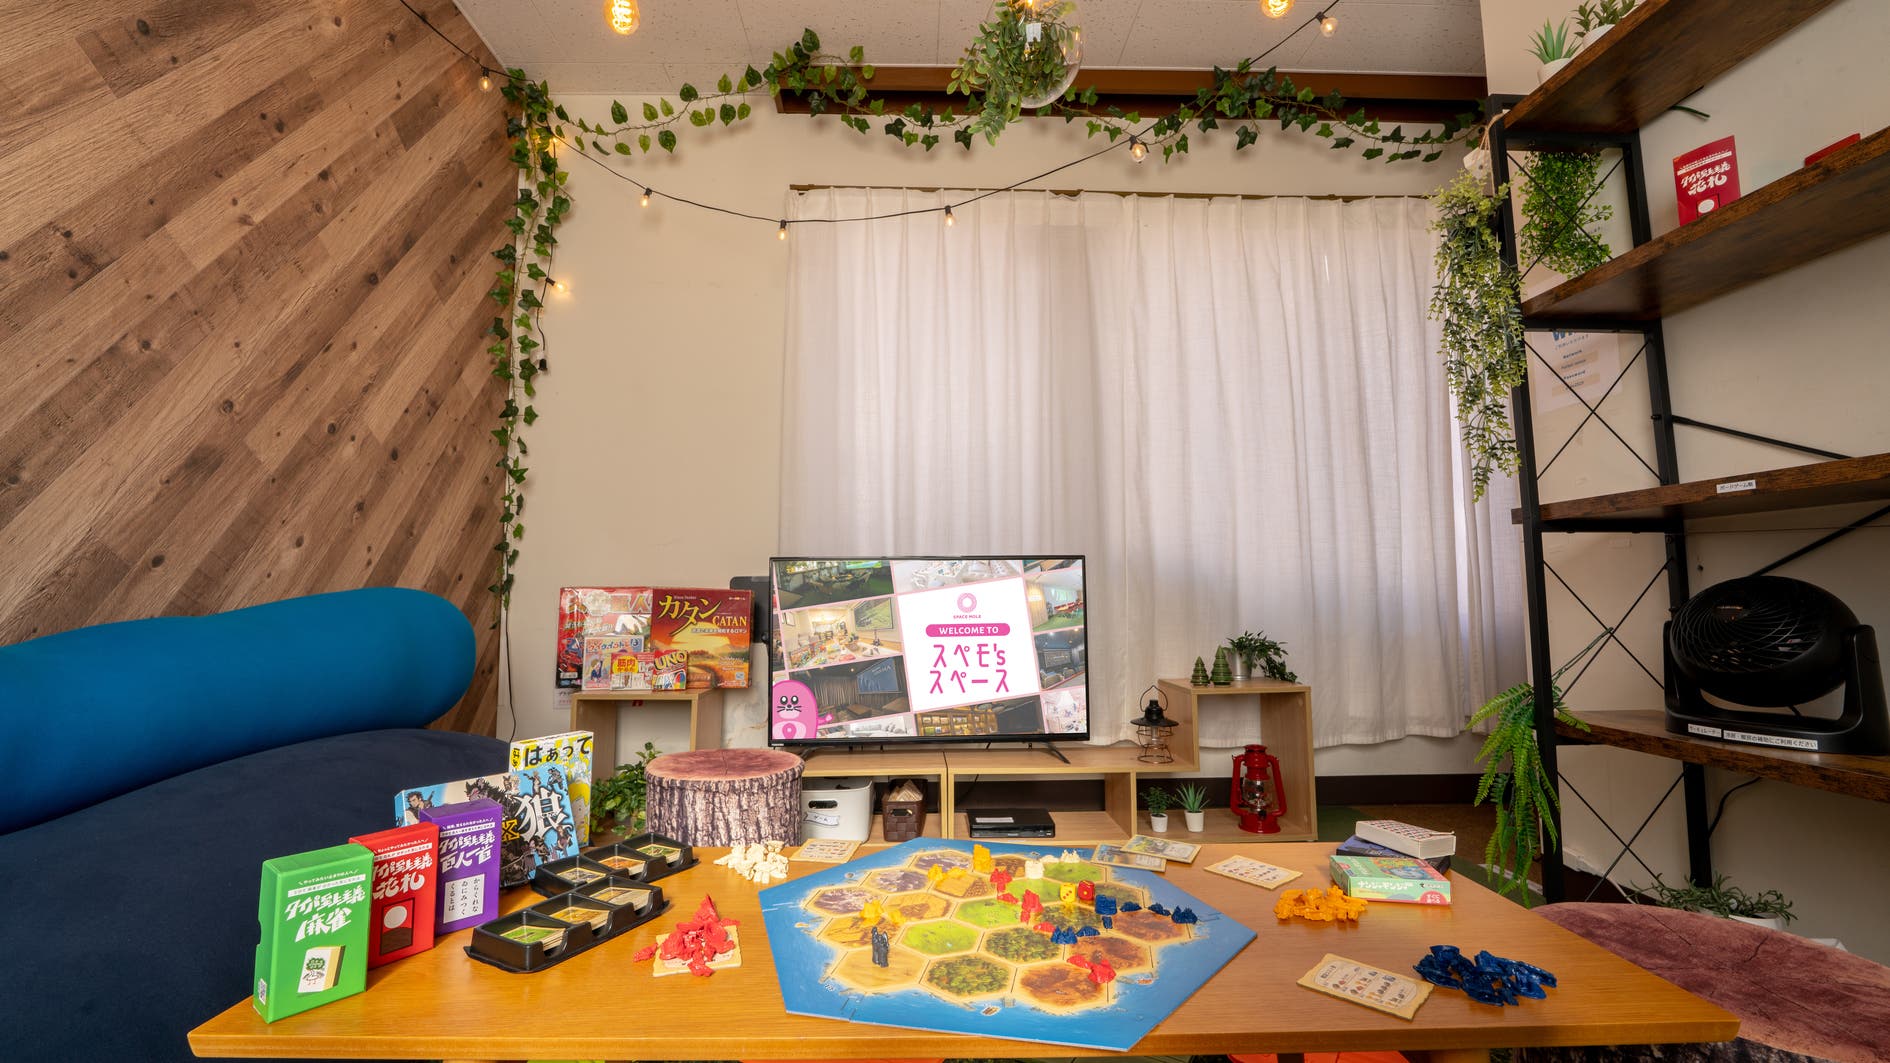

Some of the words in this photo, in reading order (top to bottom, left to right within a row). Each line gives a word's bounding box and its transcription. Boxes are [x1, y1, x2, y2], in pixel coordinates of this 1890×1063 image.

[1687, 173, 1728, 196] 花札
[657, 595, 722, 637] カタン
[712, 615, 747, 627] CATAN
[939, 627, 985, 635] WELCOME
[987, 626, 999, 634] TO
[655, 651, 687, 671] UNO
[933, 643, 1006, 668] スペモ's
[929, 669, 1010, 694] スペース
[524, 736, 593, 766] はぁって
[512, 786, 573, 843] 狼
[440, 844, 493, 873] 百人一首
[372, 871, 426, 900] 花札
[294, 907, 353, 943] 麻雀
